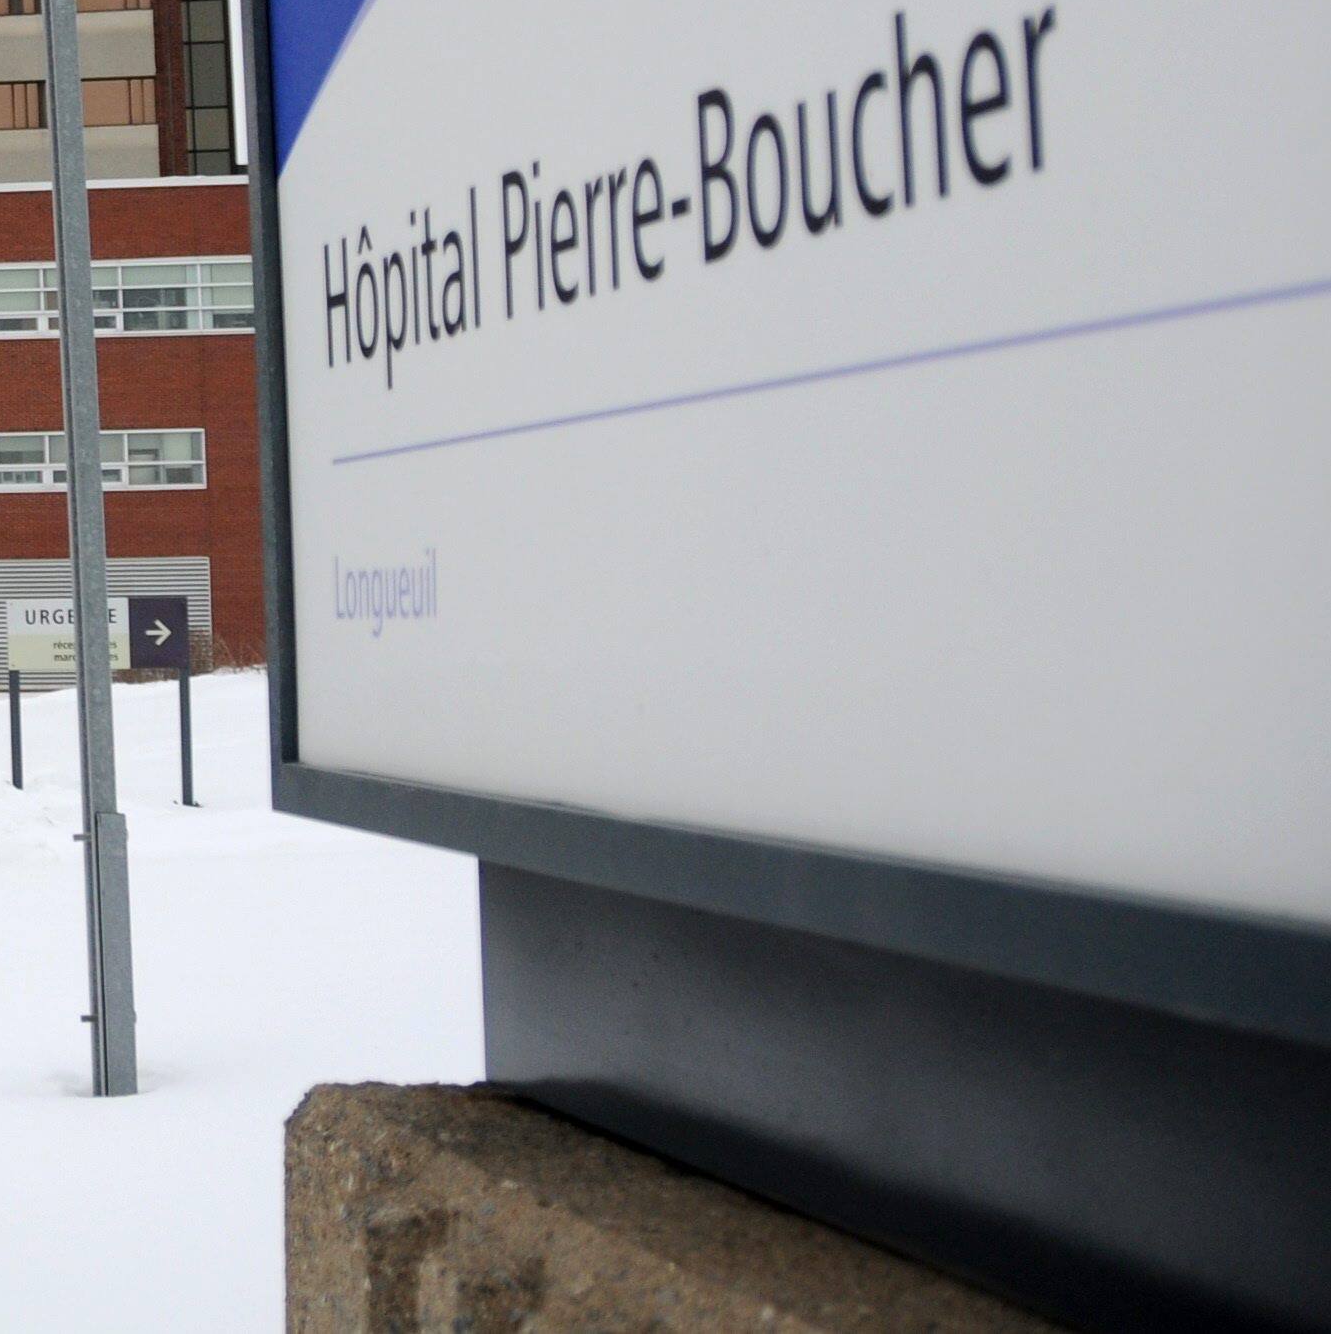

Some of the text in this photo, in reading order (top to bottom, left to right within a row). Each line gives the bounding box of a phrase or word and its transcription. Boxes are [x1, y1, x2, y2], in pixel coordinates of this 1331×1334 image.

[322, 4, 1057, 391] Hôpital Pierre-Boucher
[25, 608, 117, 625] URGEE
[334, 546, 437, 638] Longueuil
